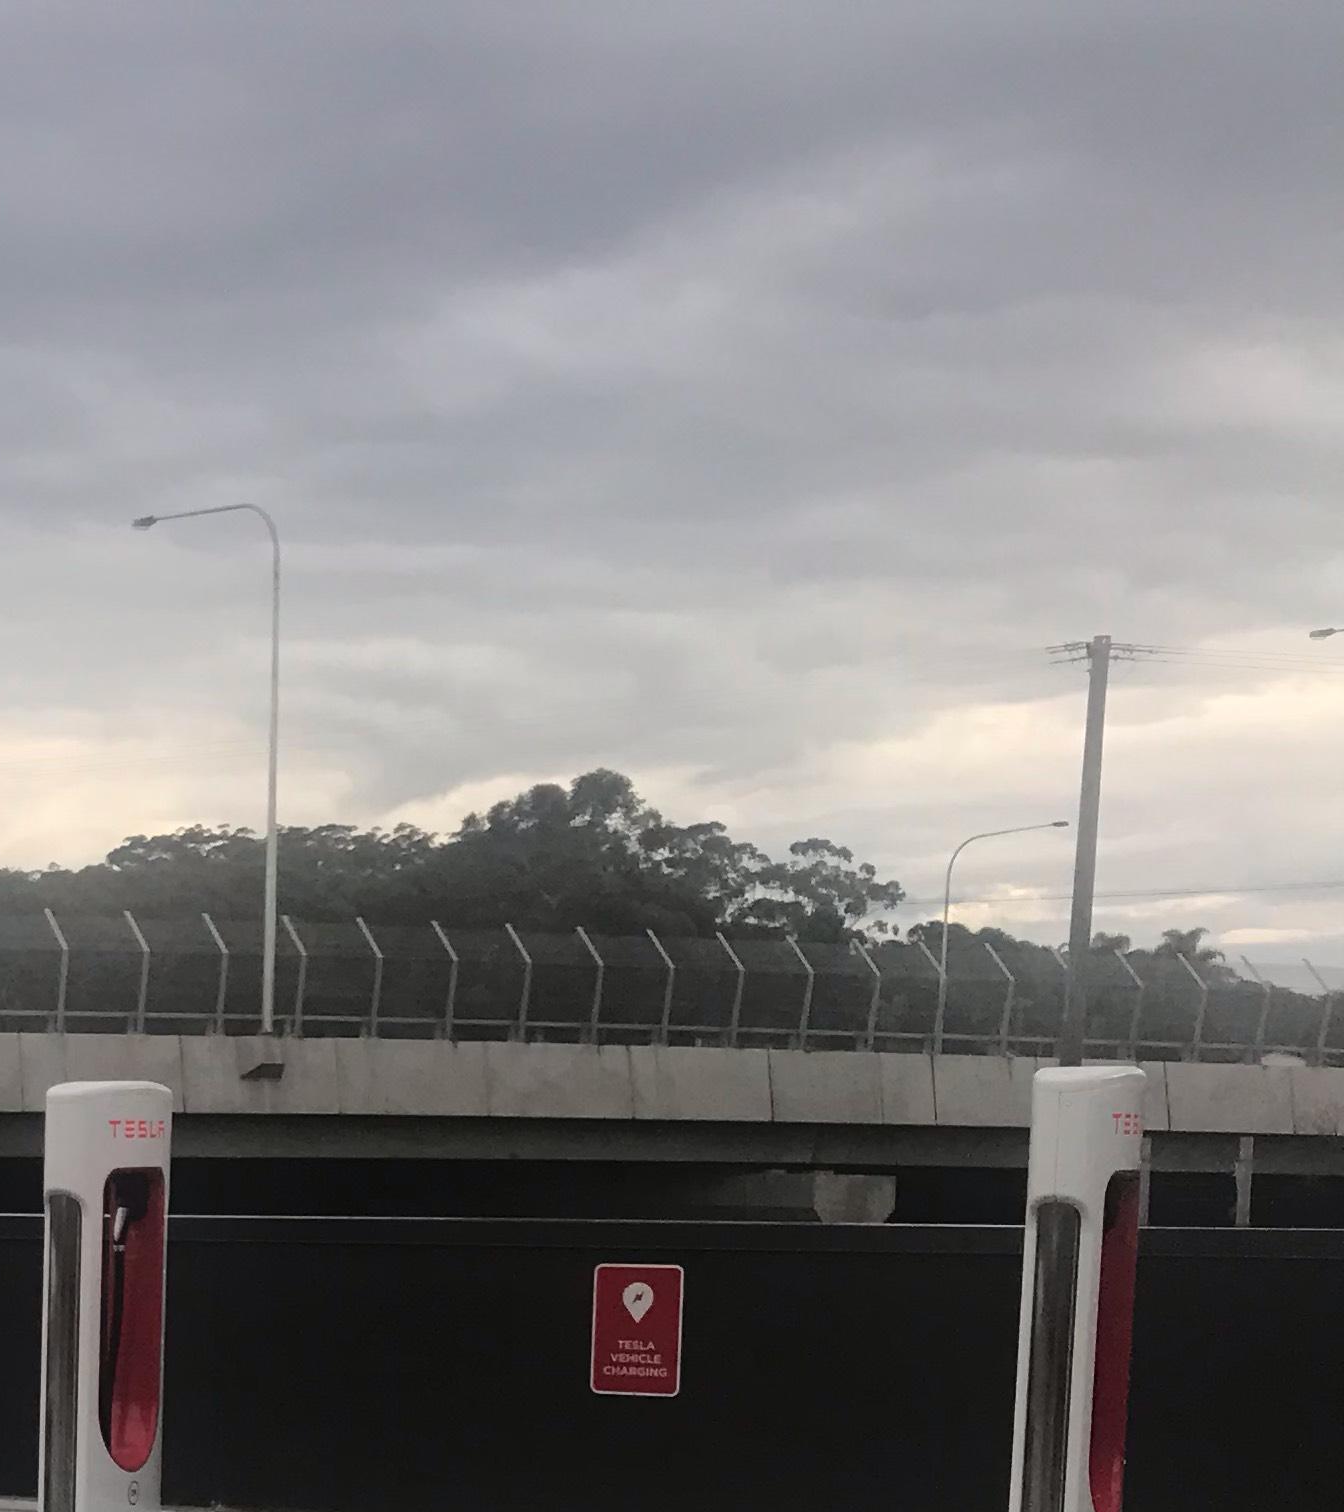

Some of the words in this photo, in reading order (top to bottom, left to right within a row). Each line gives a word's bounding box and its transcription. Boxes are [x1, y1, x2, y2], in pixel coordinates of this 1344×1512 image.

[108, 1120, 166, 1138] TESLA
[618, 1340, 655, 1350] TESLA
[610, 1353, 662, 1364] VEHICLE
[603, 1366, 667, 1377] CHARGING
